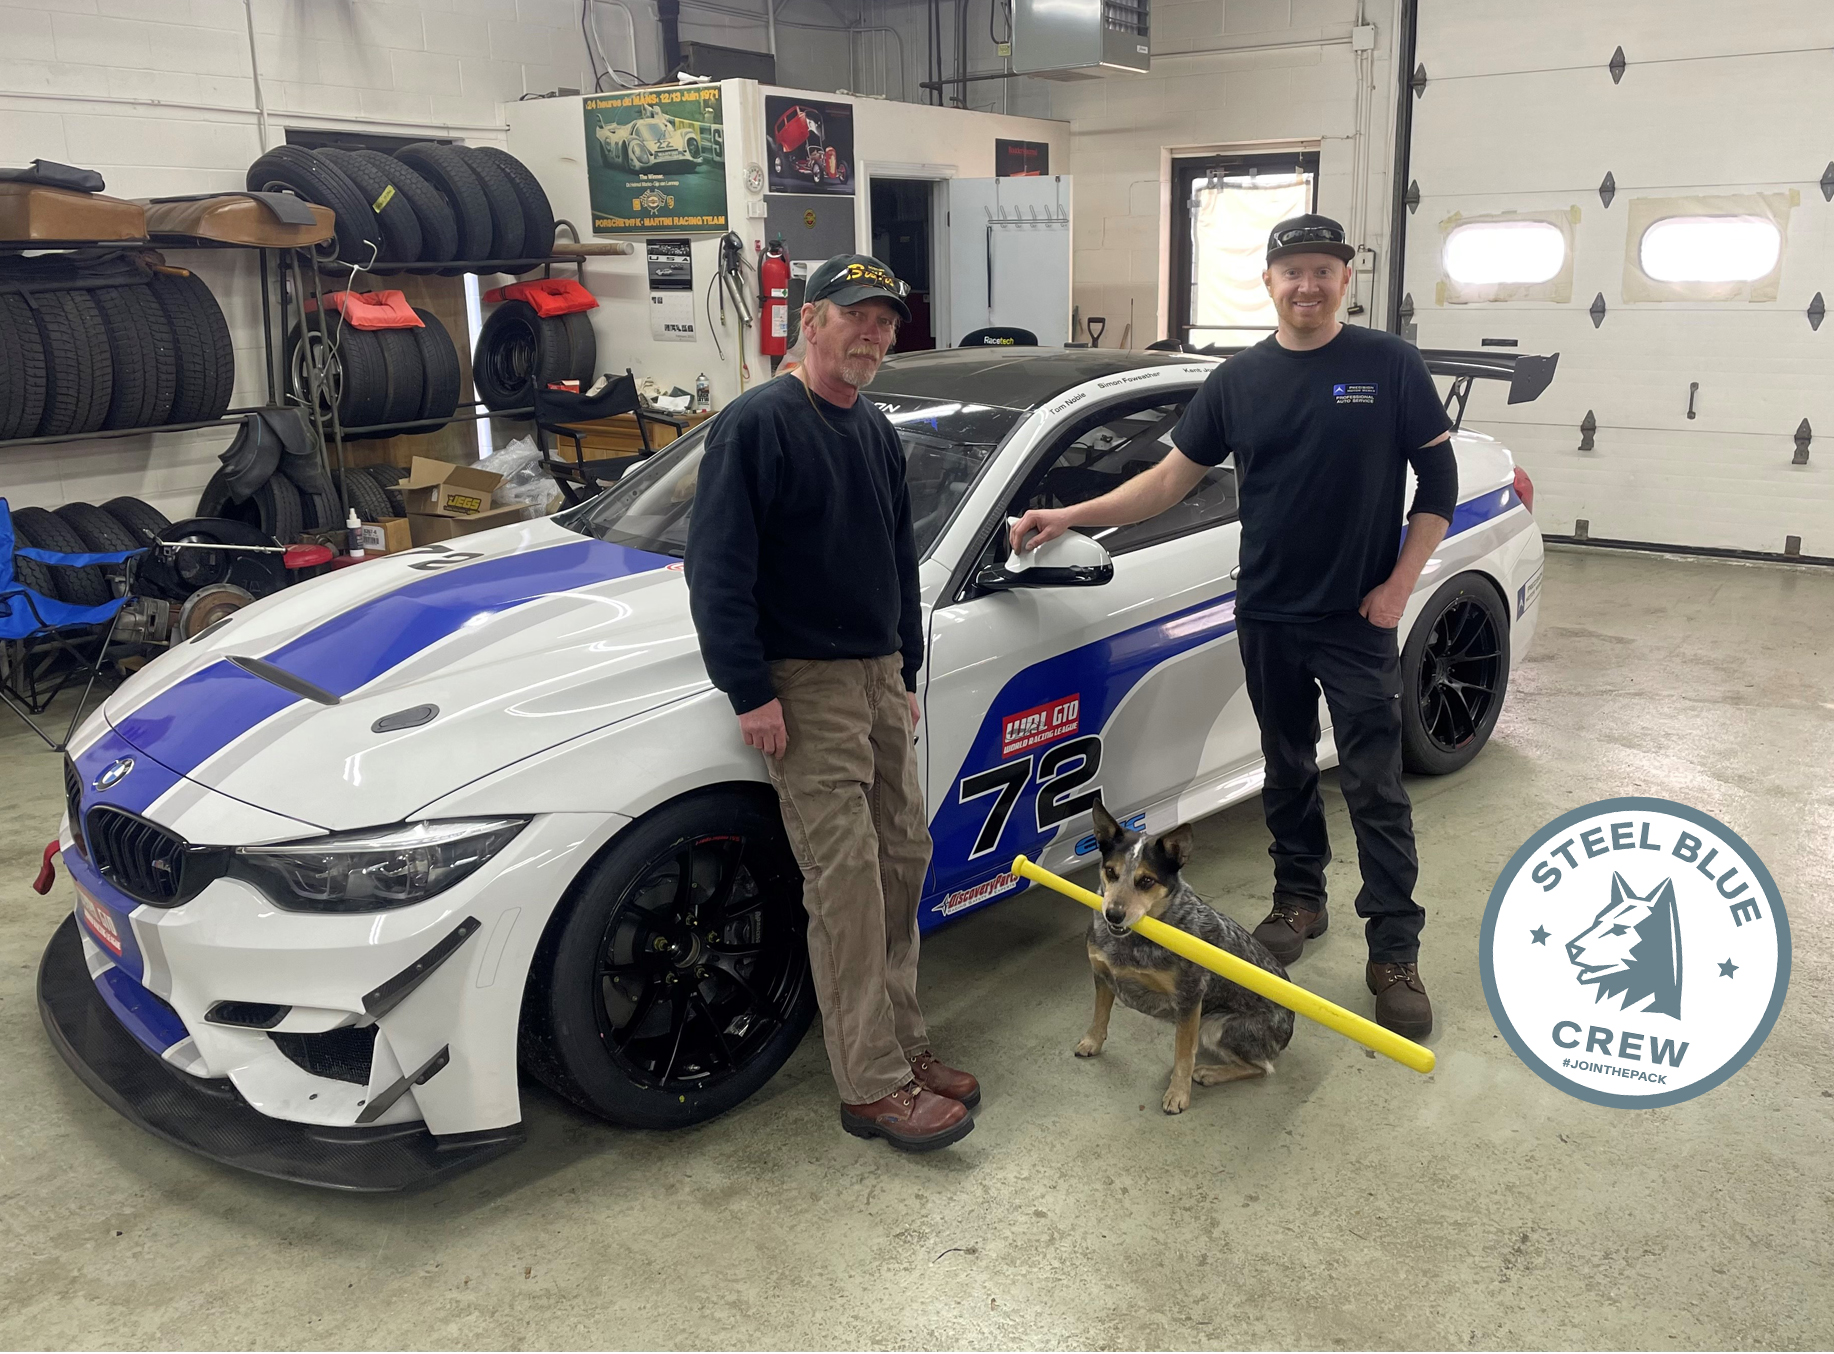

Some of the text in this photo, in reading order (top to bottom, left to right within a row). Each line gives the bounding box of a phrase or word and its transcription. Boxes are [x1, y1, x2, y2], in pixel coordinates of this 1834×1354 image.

[660, 91, 681, 103] 12/13
[682, 90, 699, 101] Juin
[700, 88, 719, 99] 1971
[655, 140, 674, 149] 22
[674, 216, 703, 225] RACING
[703, 215, 725, 224] TEAM
[984, 336, 1014, 345] Racetech
[1097, 379, 1122, 389] Simon
[1049, 392, 1087, 416] Tom Noble
[447, 496, 481, 509] JEGS
[1005, 710, 1048, 743] WRL
[1003, 721, 1078, 754] WORLD RACING LEAGUE
[959, 734, 1105, 861] 72
